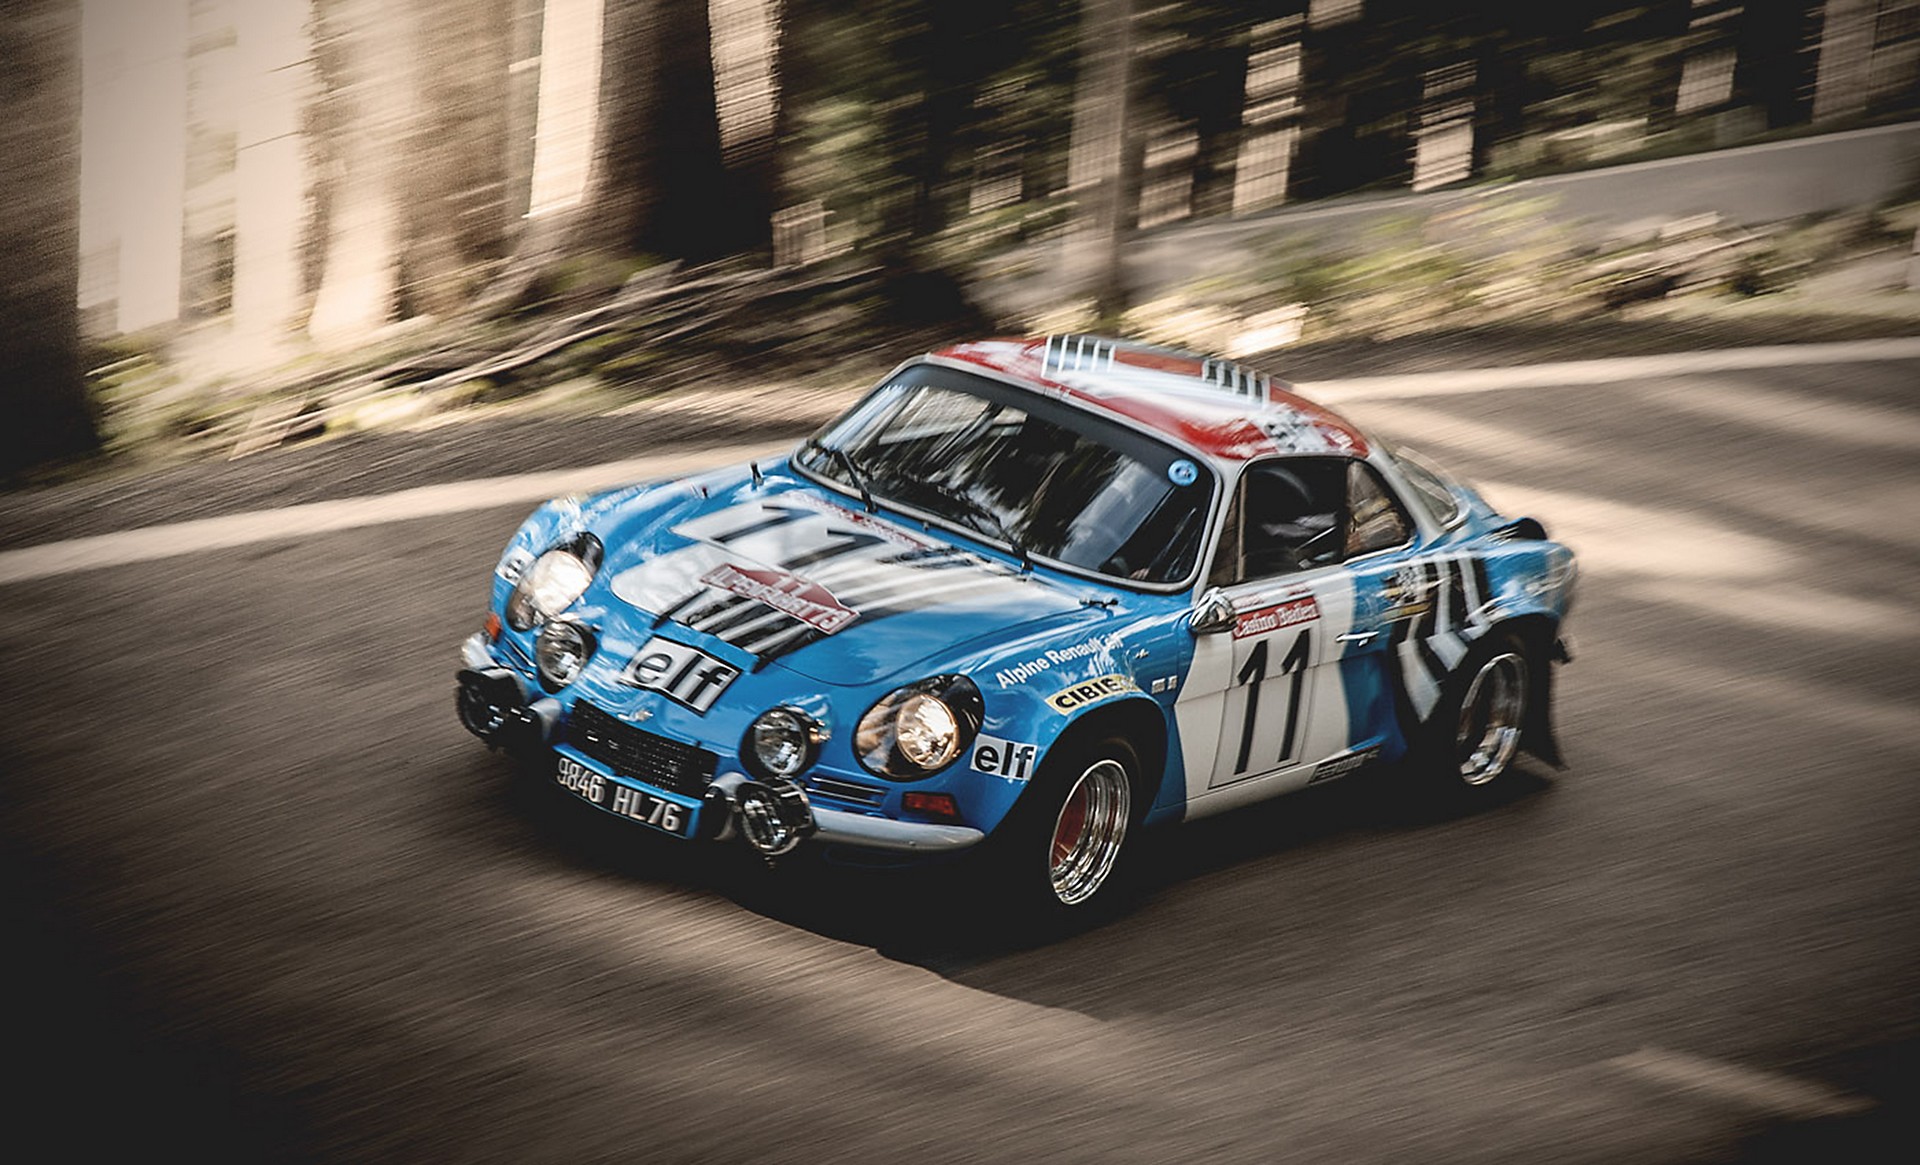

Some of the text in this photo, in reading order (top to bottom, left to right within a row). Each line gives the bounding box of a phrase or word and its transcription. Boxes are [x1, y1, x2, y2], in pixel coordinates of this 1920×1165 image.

[633, 653, 732, 704] elf
[995, 657, 1051, 690] Alpine
[1233, 627, 1312, 776] 11
[557, 757, 606, 803] 9846
[974, 742, 1034, 778] elf
